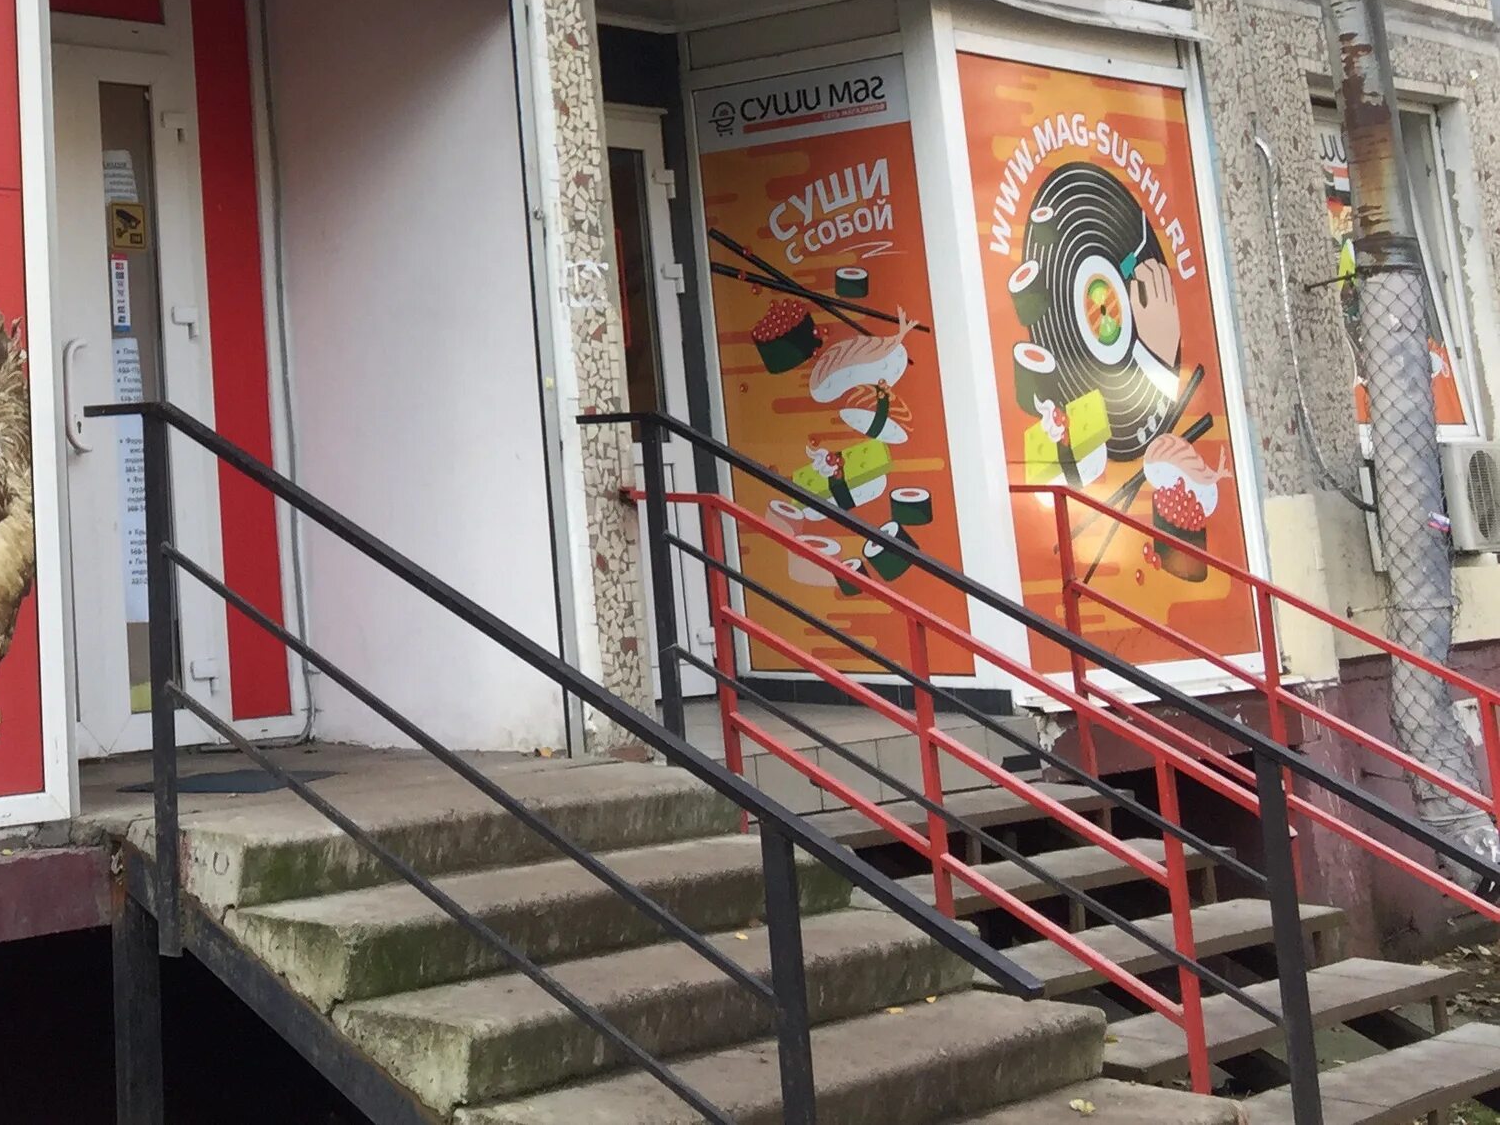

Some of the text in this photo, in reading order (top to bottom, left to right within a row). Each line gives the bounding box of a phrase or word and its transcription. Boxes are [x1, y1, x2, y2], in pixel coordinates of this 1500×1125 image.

[769, 158, 890, 242] СУШИ
[786, 198, 893, 264] С СОБОЙ
